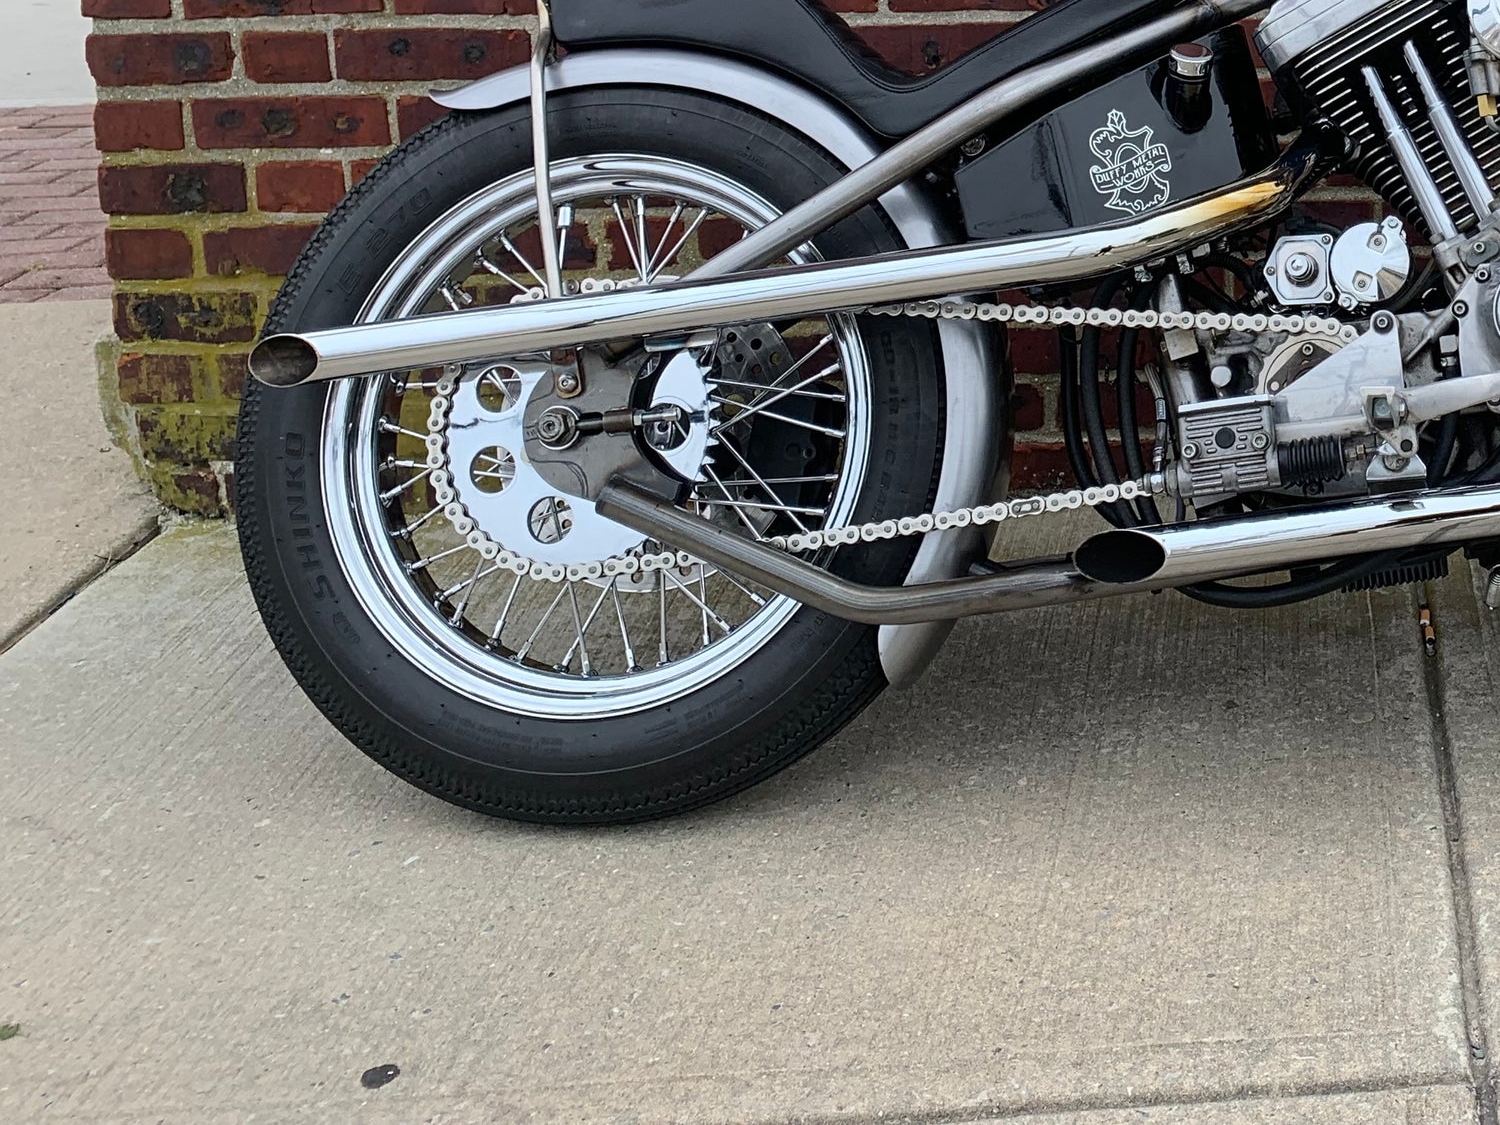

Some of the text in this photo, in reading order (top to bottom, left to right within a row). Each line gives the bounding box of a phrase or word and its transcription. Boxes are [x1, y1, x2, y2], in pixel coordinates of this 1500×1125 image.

[1095, 146, 1165, 184] DUFFY METAL
[1112, 161, 1155, 186] WORKS
[285, 432, 337, 600] SHINKO
